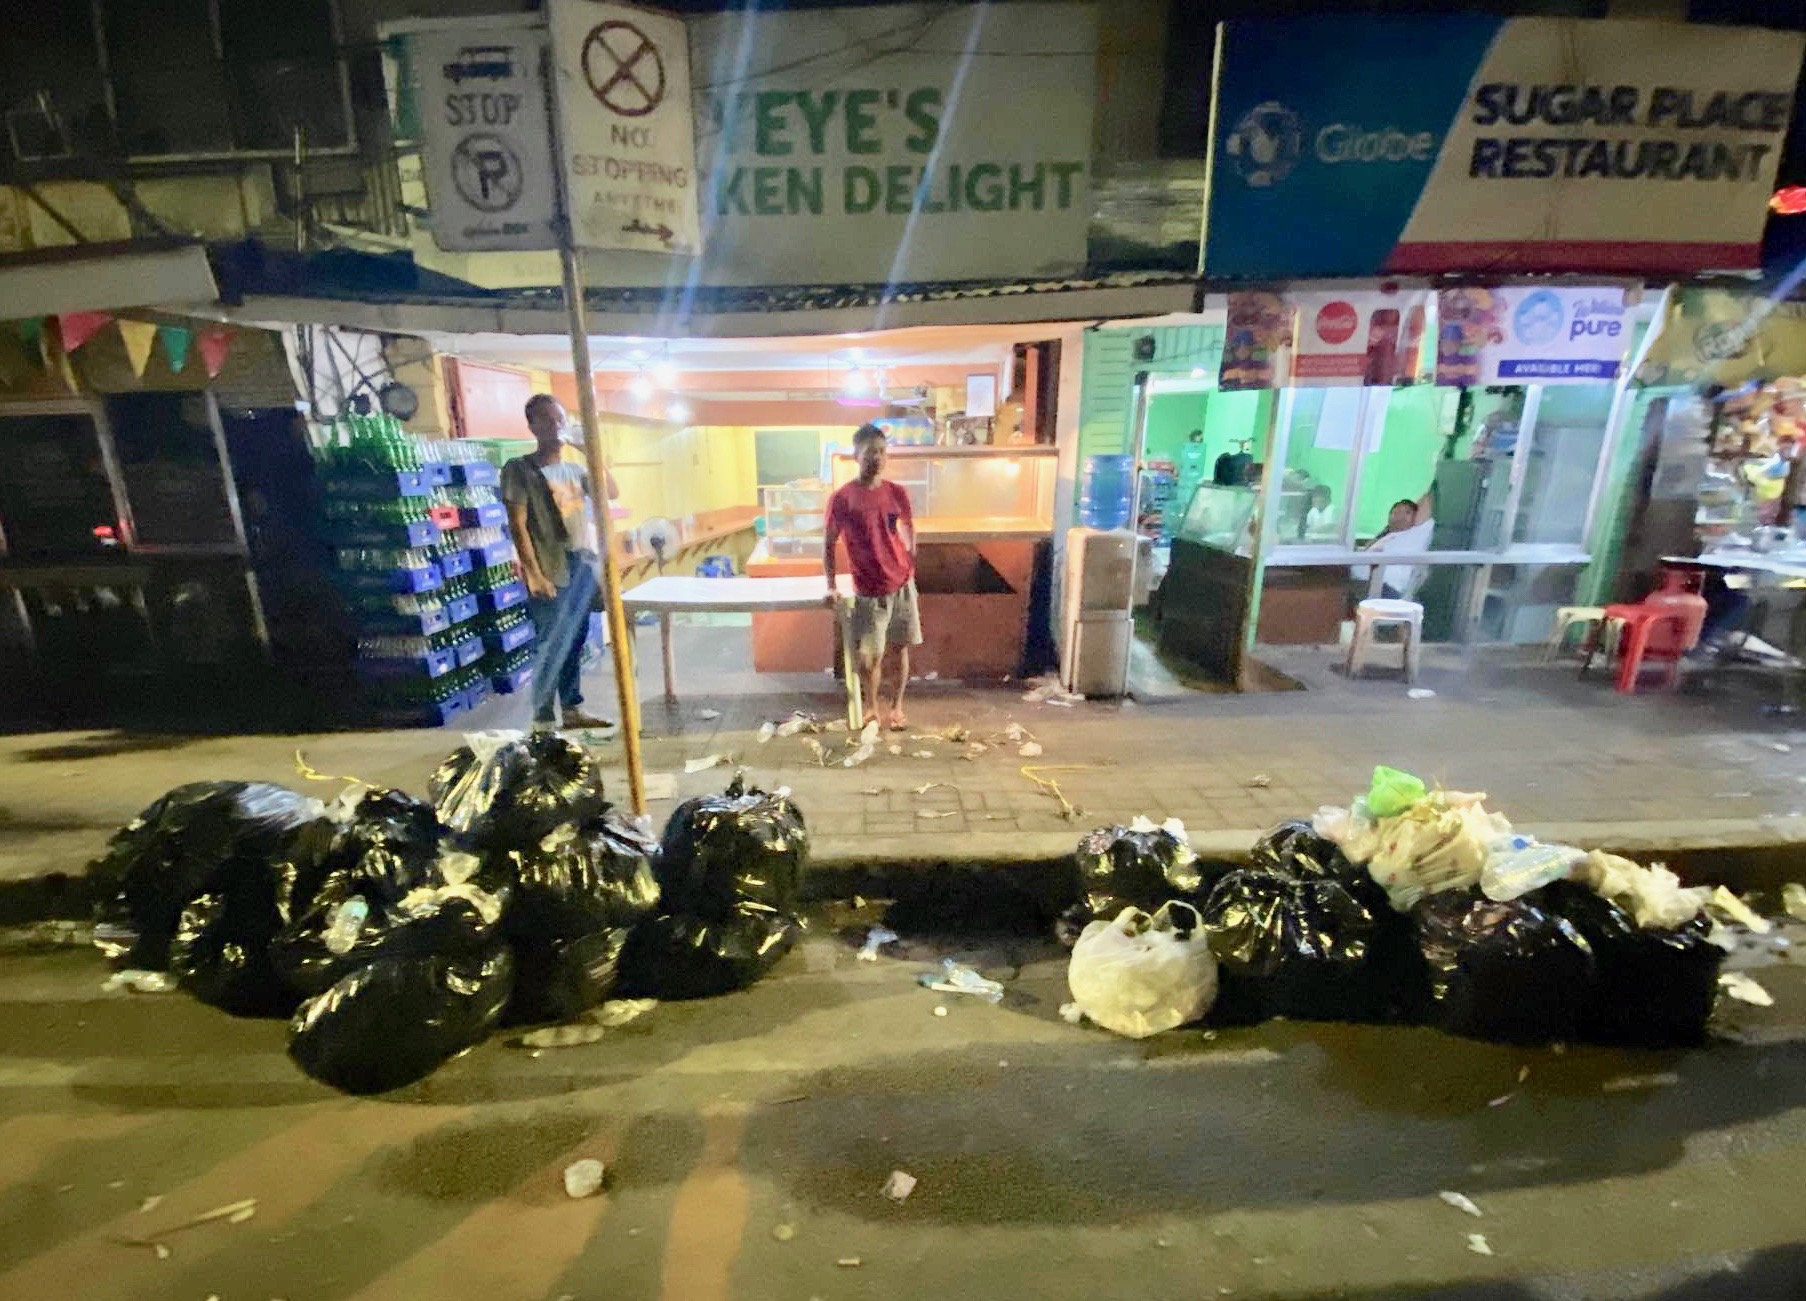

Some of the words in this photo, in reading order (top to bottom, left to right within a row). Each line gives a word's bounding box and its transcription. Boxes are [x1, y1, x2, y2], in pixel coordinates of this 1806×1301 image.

[446, 92, 522, 126] STOP
[1473, 83, 1640, 125] SUGAR
[1649, 86, 1791, 132] PLACE
[611, 124, 650, 148] NO
[1316, 123, 1434, 163] Globe
[1469, 138, 1772, 182] RESTAURANT
[844, 161, 1083, 214] DELIGHT
[1569, 319, 1622, 341] pure
